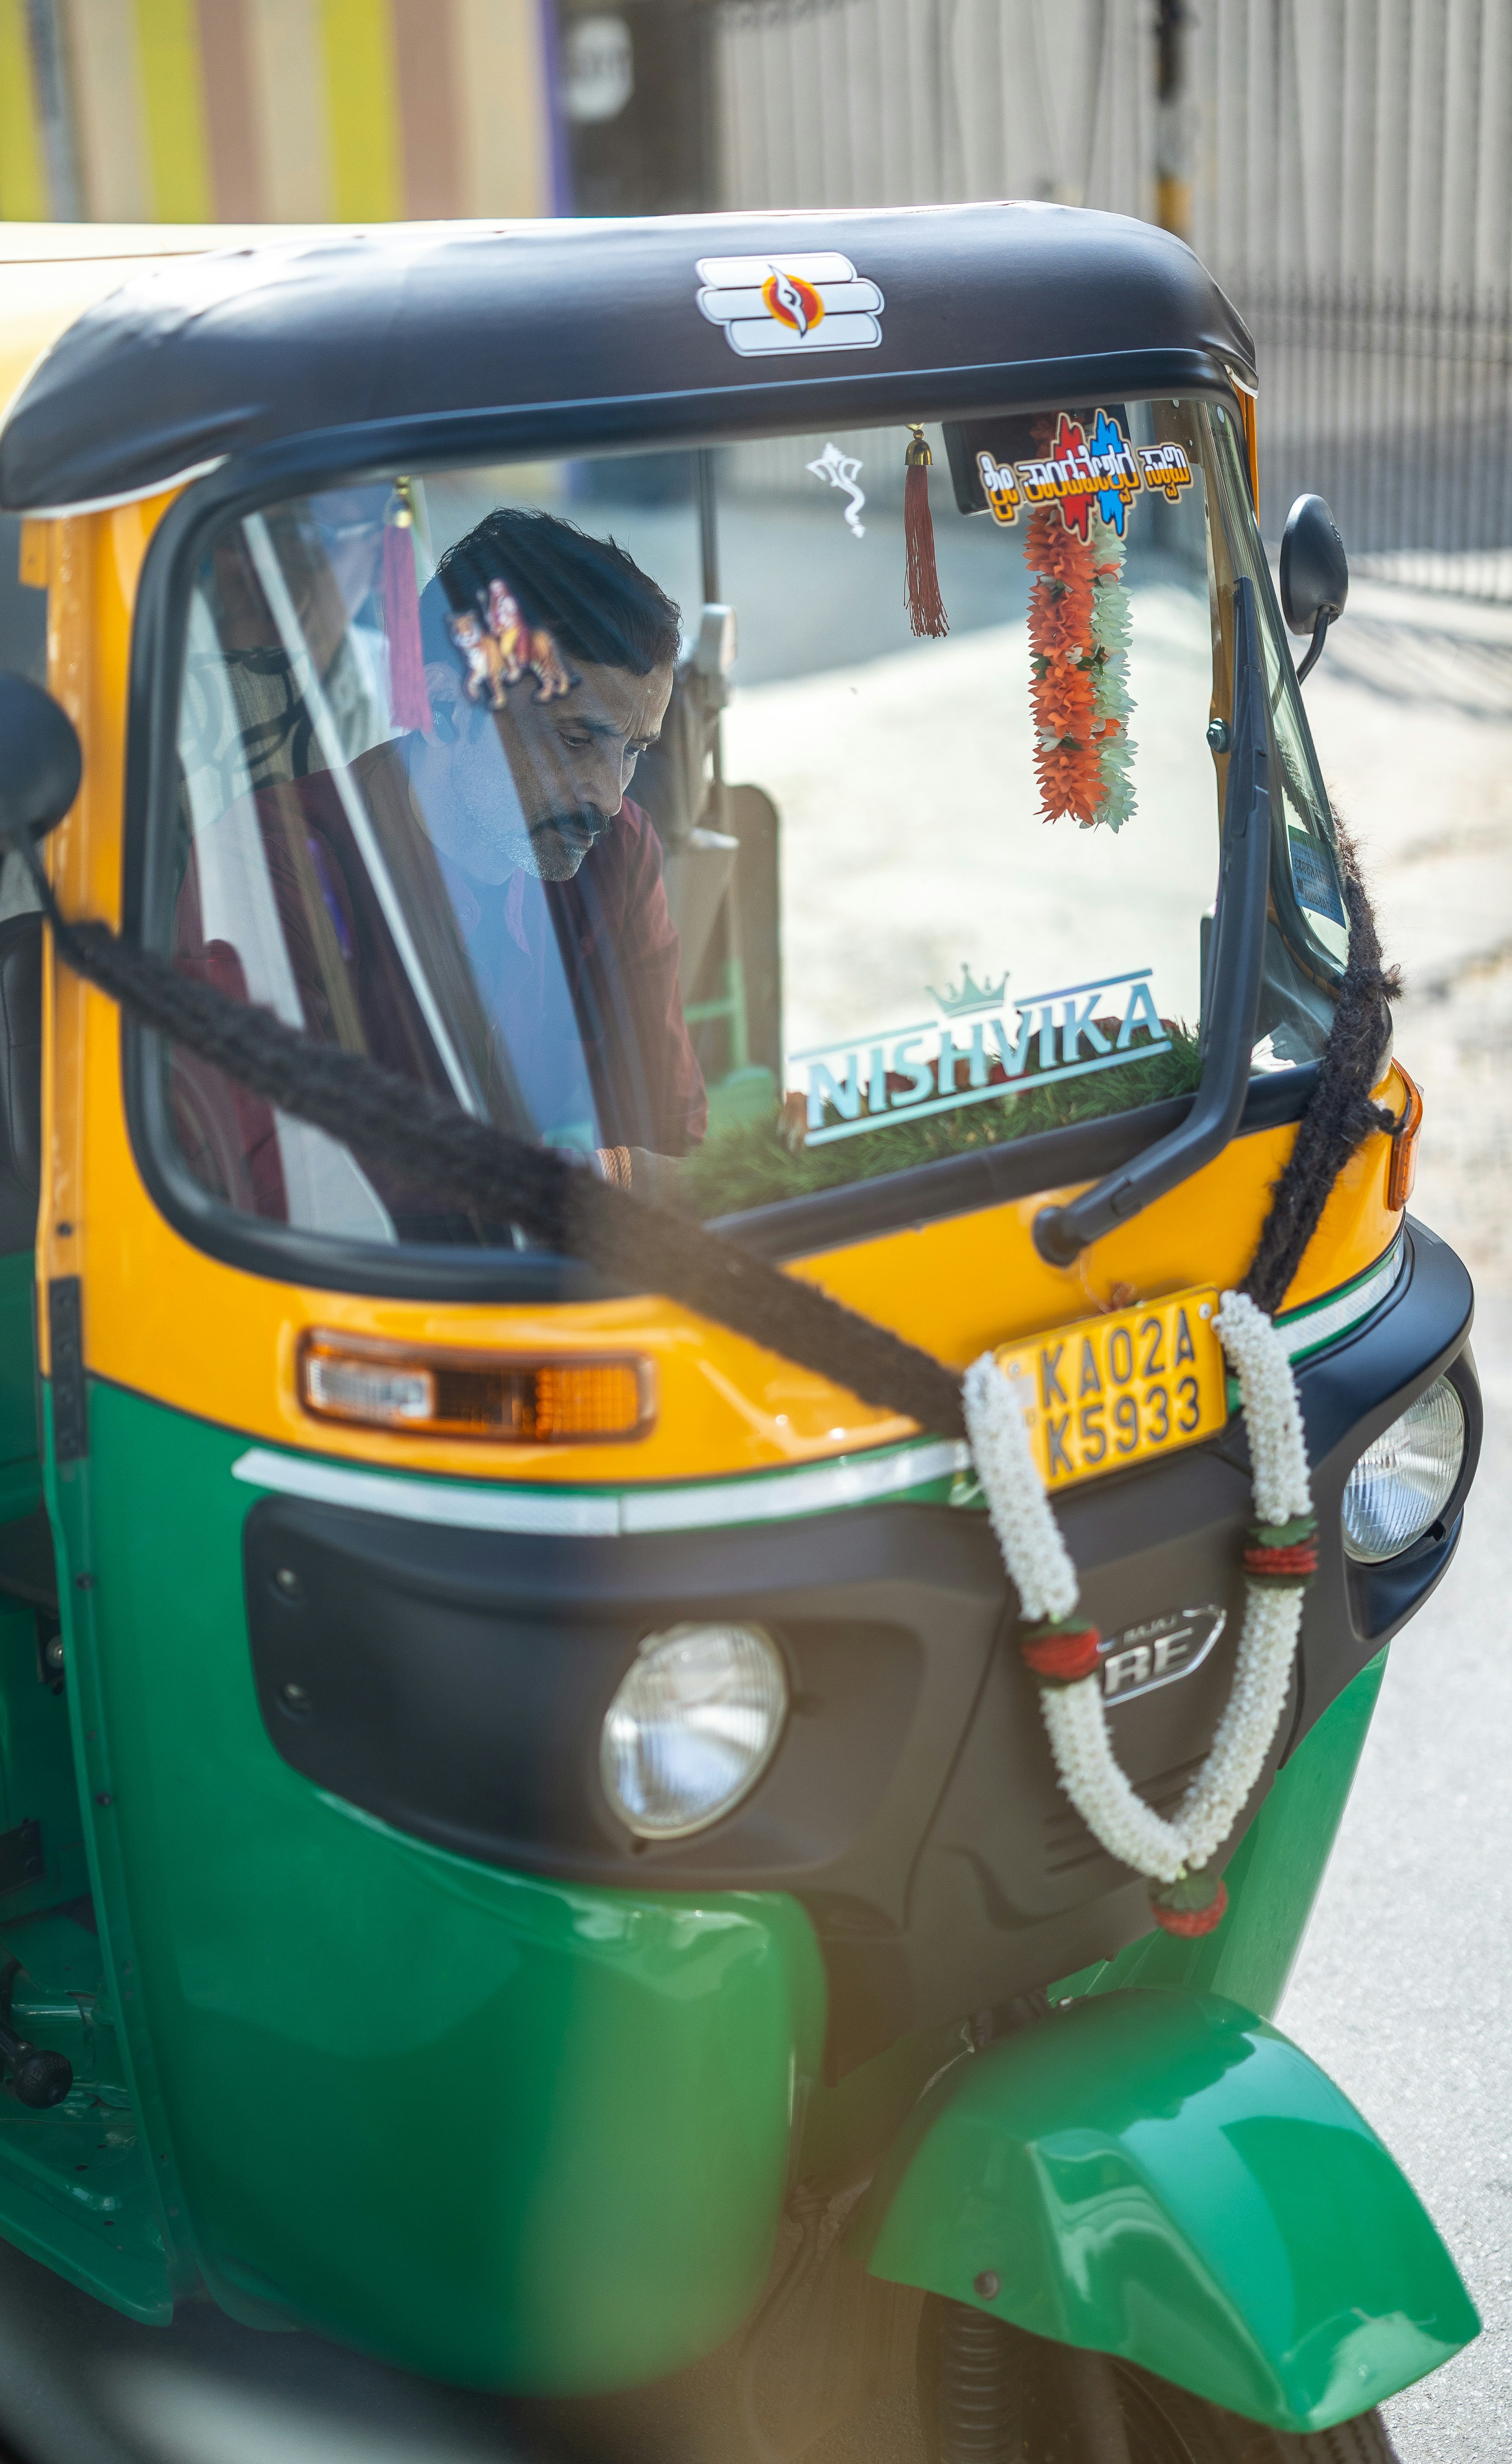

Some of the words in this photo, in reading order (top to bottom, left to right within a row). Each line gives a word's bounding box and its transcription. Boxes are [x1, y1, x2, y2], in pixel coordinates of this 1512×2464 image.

[980, 454, 1020, 520] ಶ್ರೀ
[1139, 446, 1191, 498] ಸ್ವಾಮಿ
[805, 983, 1166, 1130] NISHVIKA
[1040, 1308, 1195, 1408] KA02A
[1045, 1377, 1200, 1477] K5933
[1104, 1627, 1193, 1695] RE
